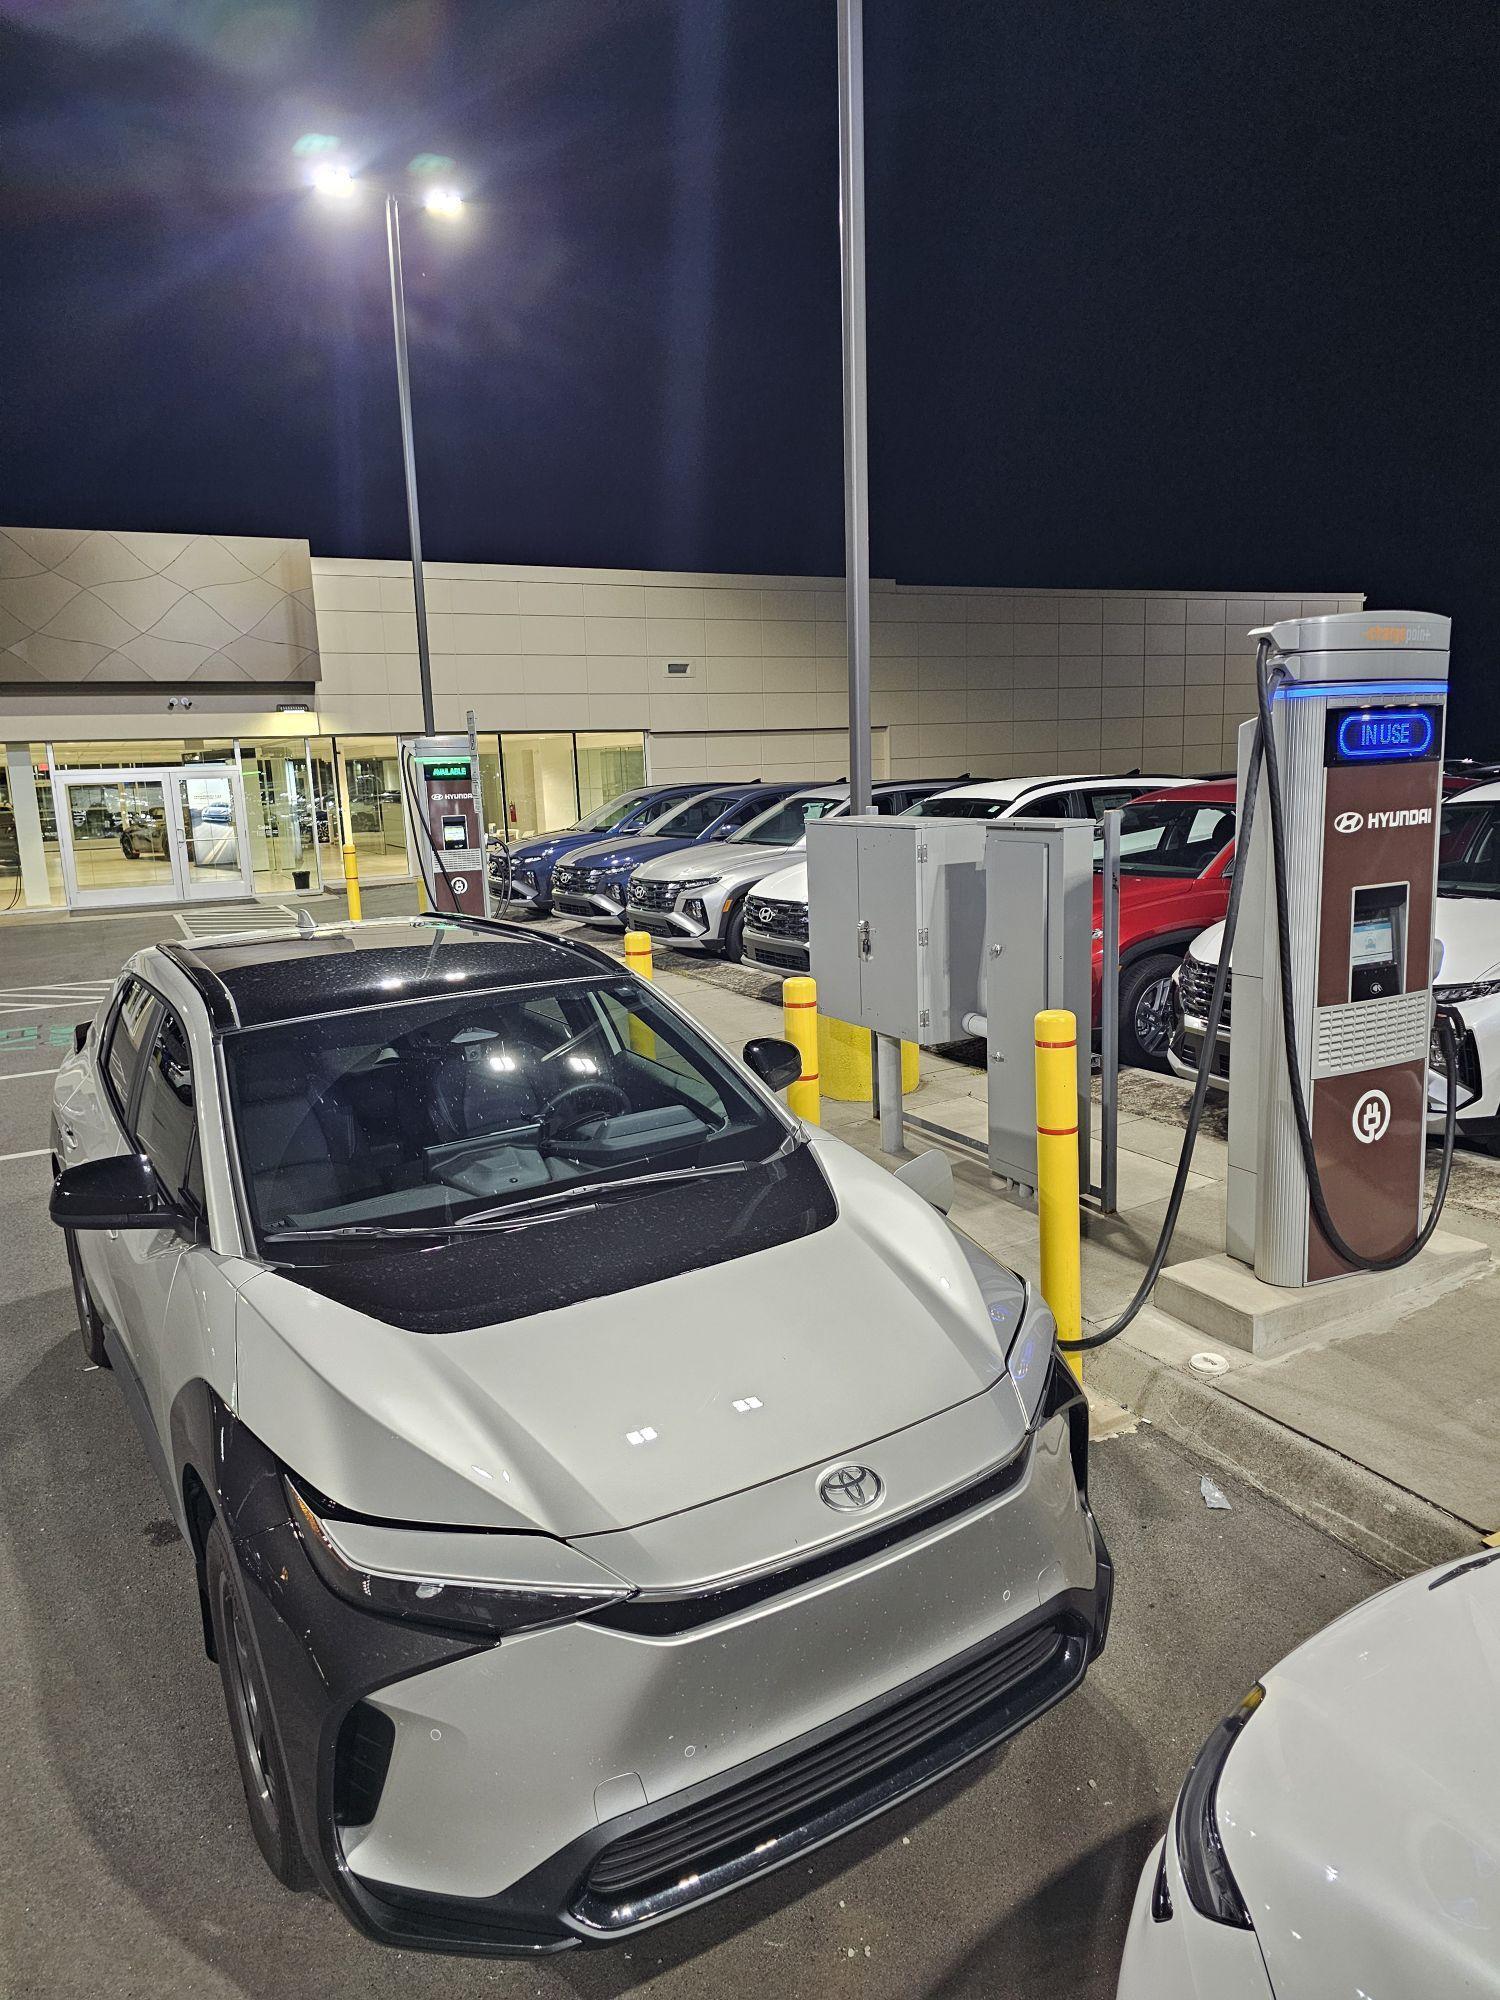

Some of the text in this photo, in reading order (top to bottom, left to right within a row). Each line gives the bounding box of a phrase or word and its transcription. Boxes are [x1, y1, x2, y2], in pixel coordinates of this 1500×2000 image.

[1361, 723, 1410, 746] IN USE
[432, 767, 467, 776] AVAILABLE
[444, 792, 473, 800] HYUNDA
[1367, 808, 1432, 829] HYUNDAI
